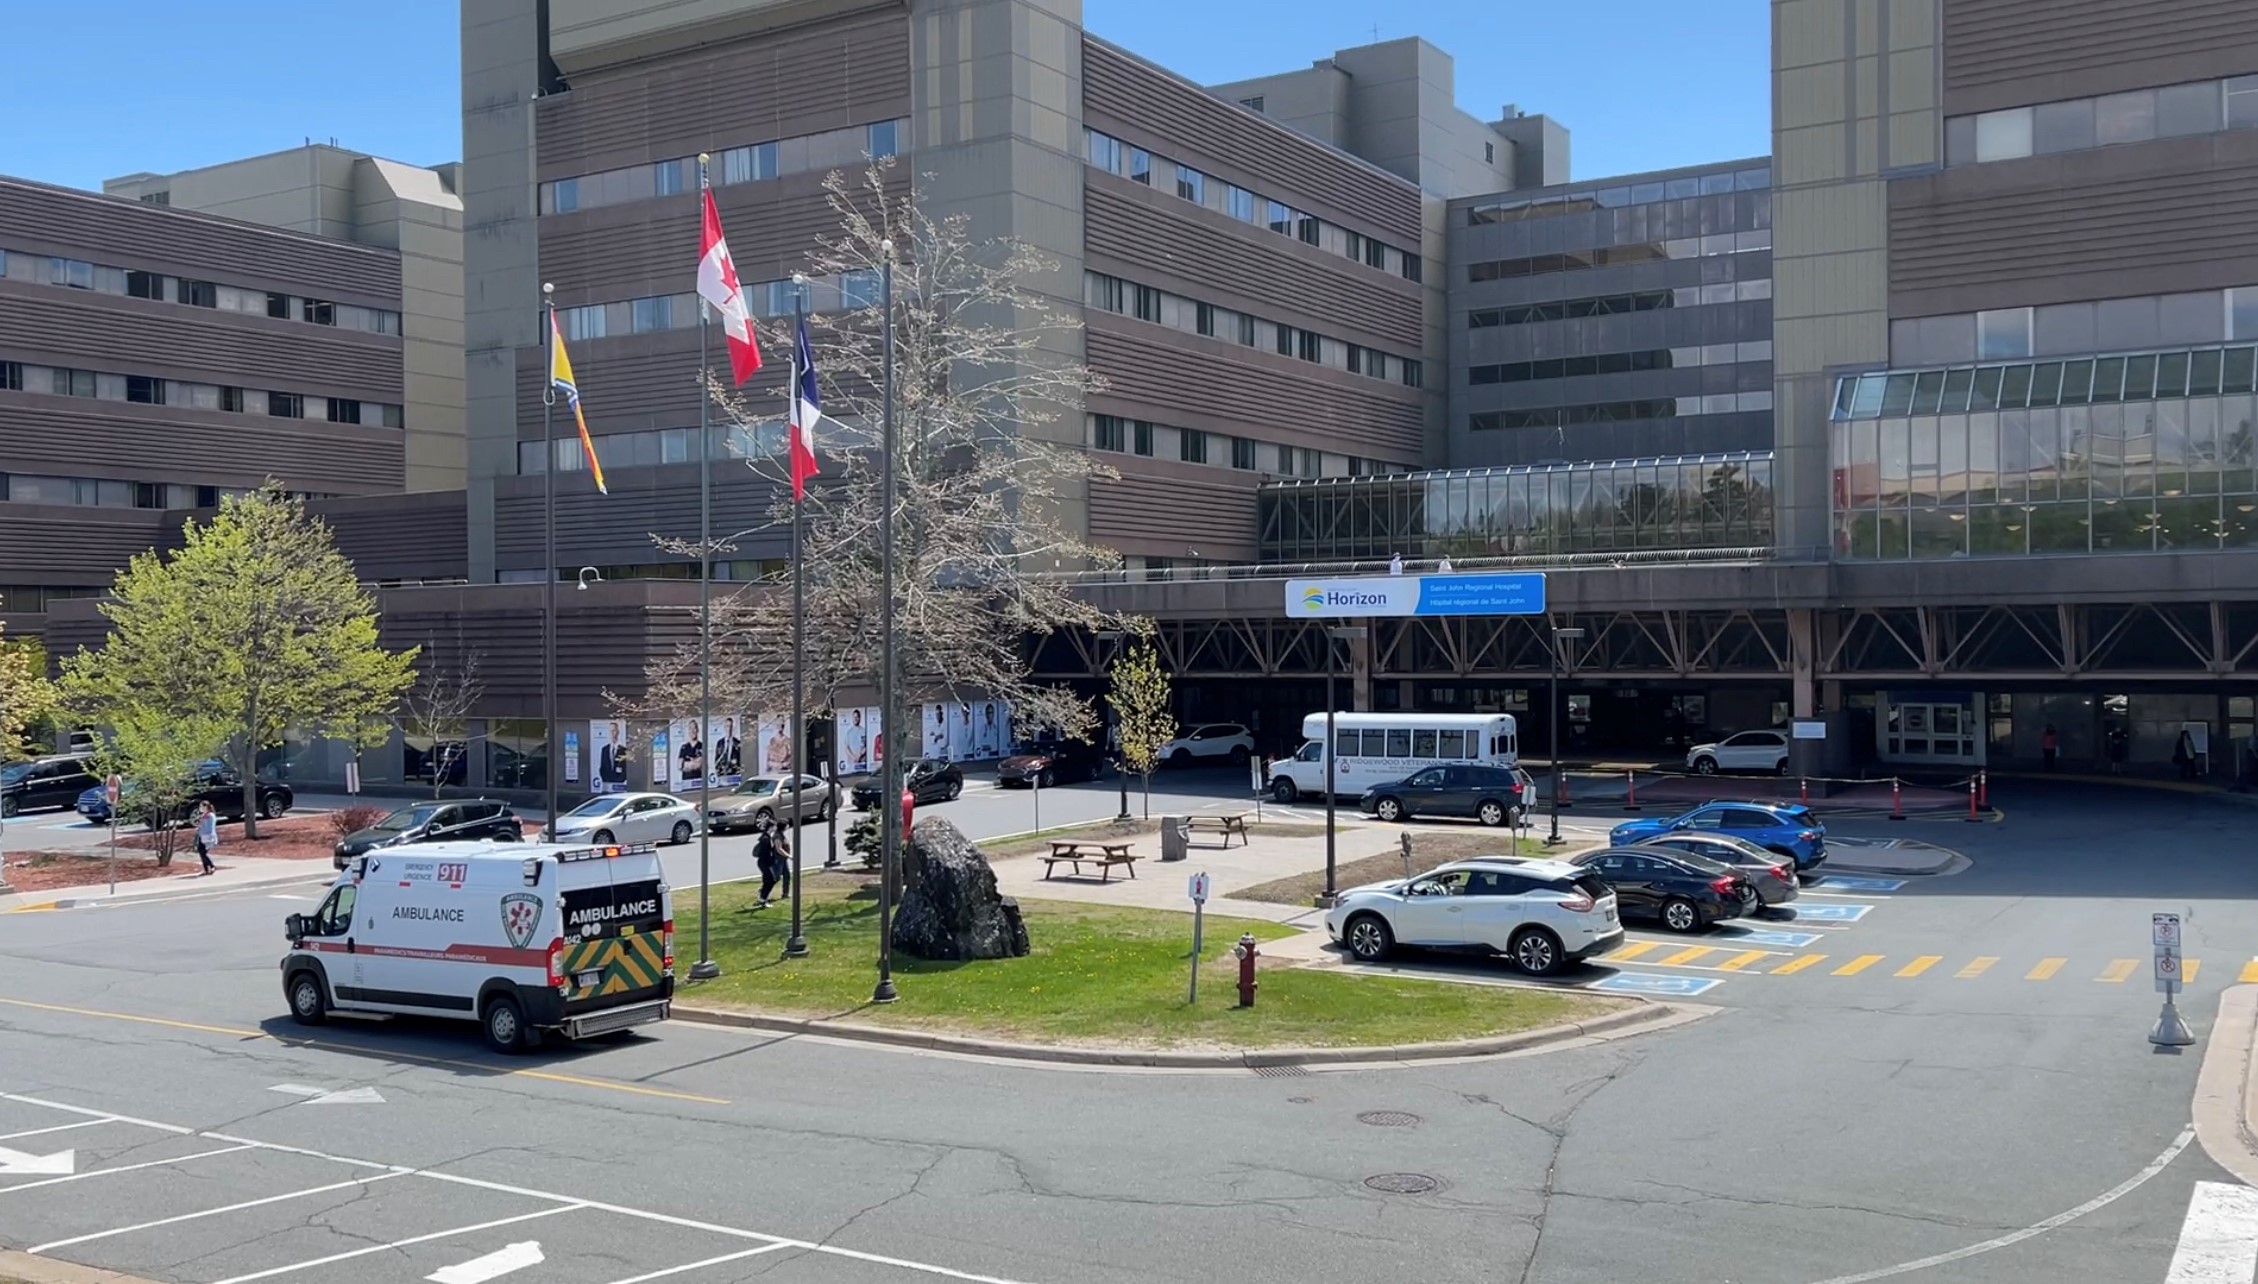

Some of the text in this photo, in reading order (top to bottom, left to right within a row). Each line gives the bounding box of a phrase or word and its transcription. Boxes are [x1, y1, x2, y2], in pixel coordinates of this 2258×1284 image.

[1464, 583, 1494, 592] Regional
[1494, 583, 1522, 592] Hospital
[1327, 591, 1387, 605] Horizon
[1490, 597, 1507, 605] Saint
[1508, 597, 1526, 605] John
[403, 873, 432, 881] URGENCE
[440, 864, 466, 882] 911
[392, 906, 465, 922] AMBULANCE
[569, 899, 657, 926] AMBULANCE
